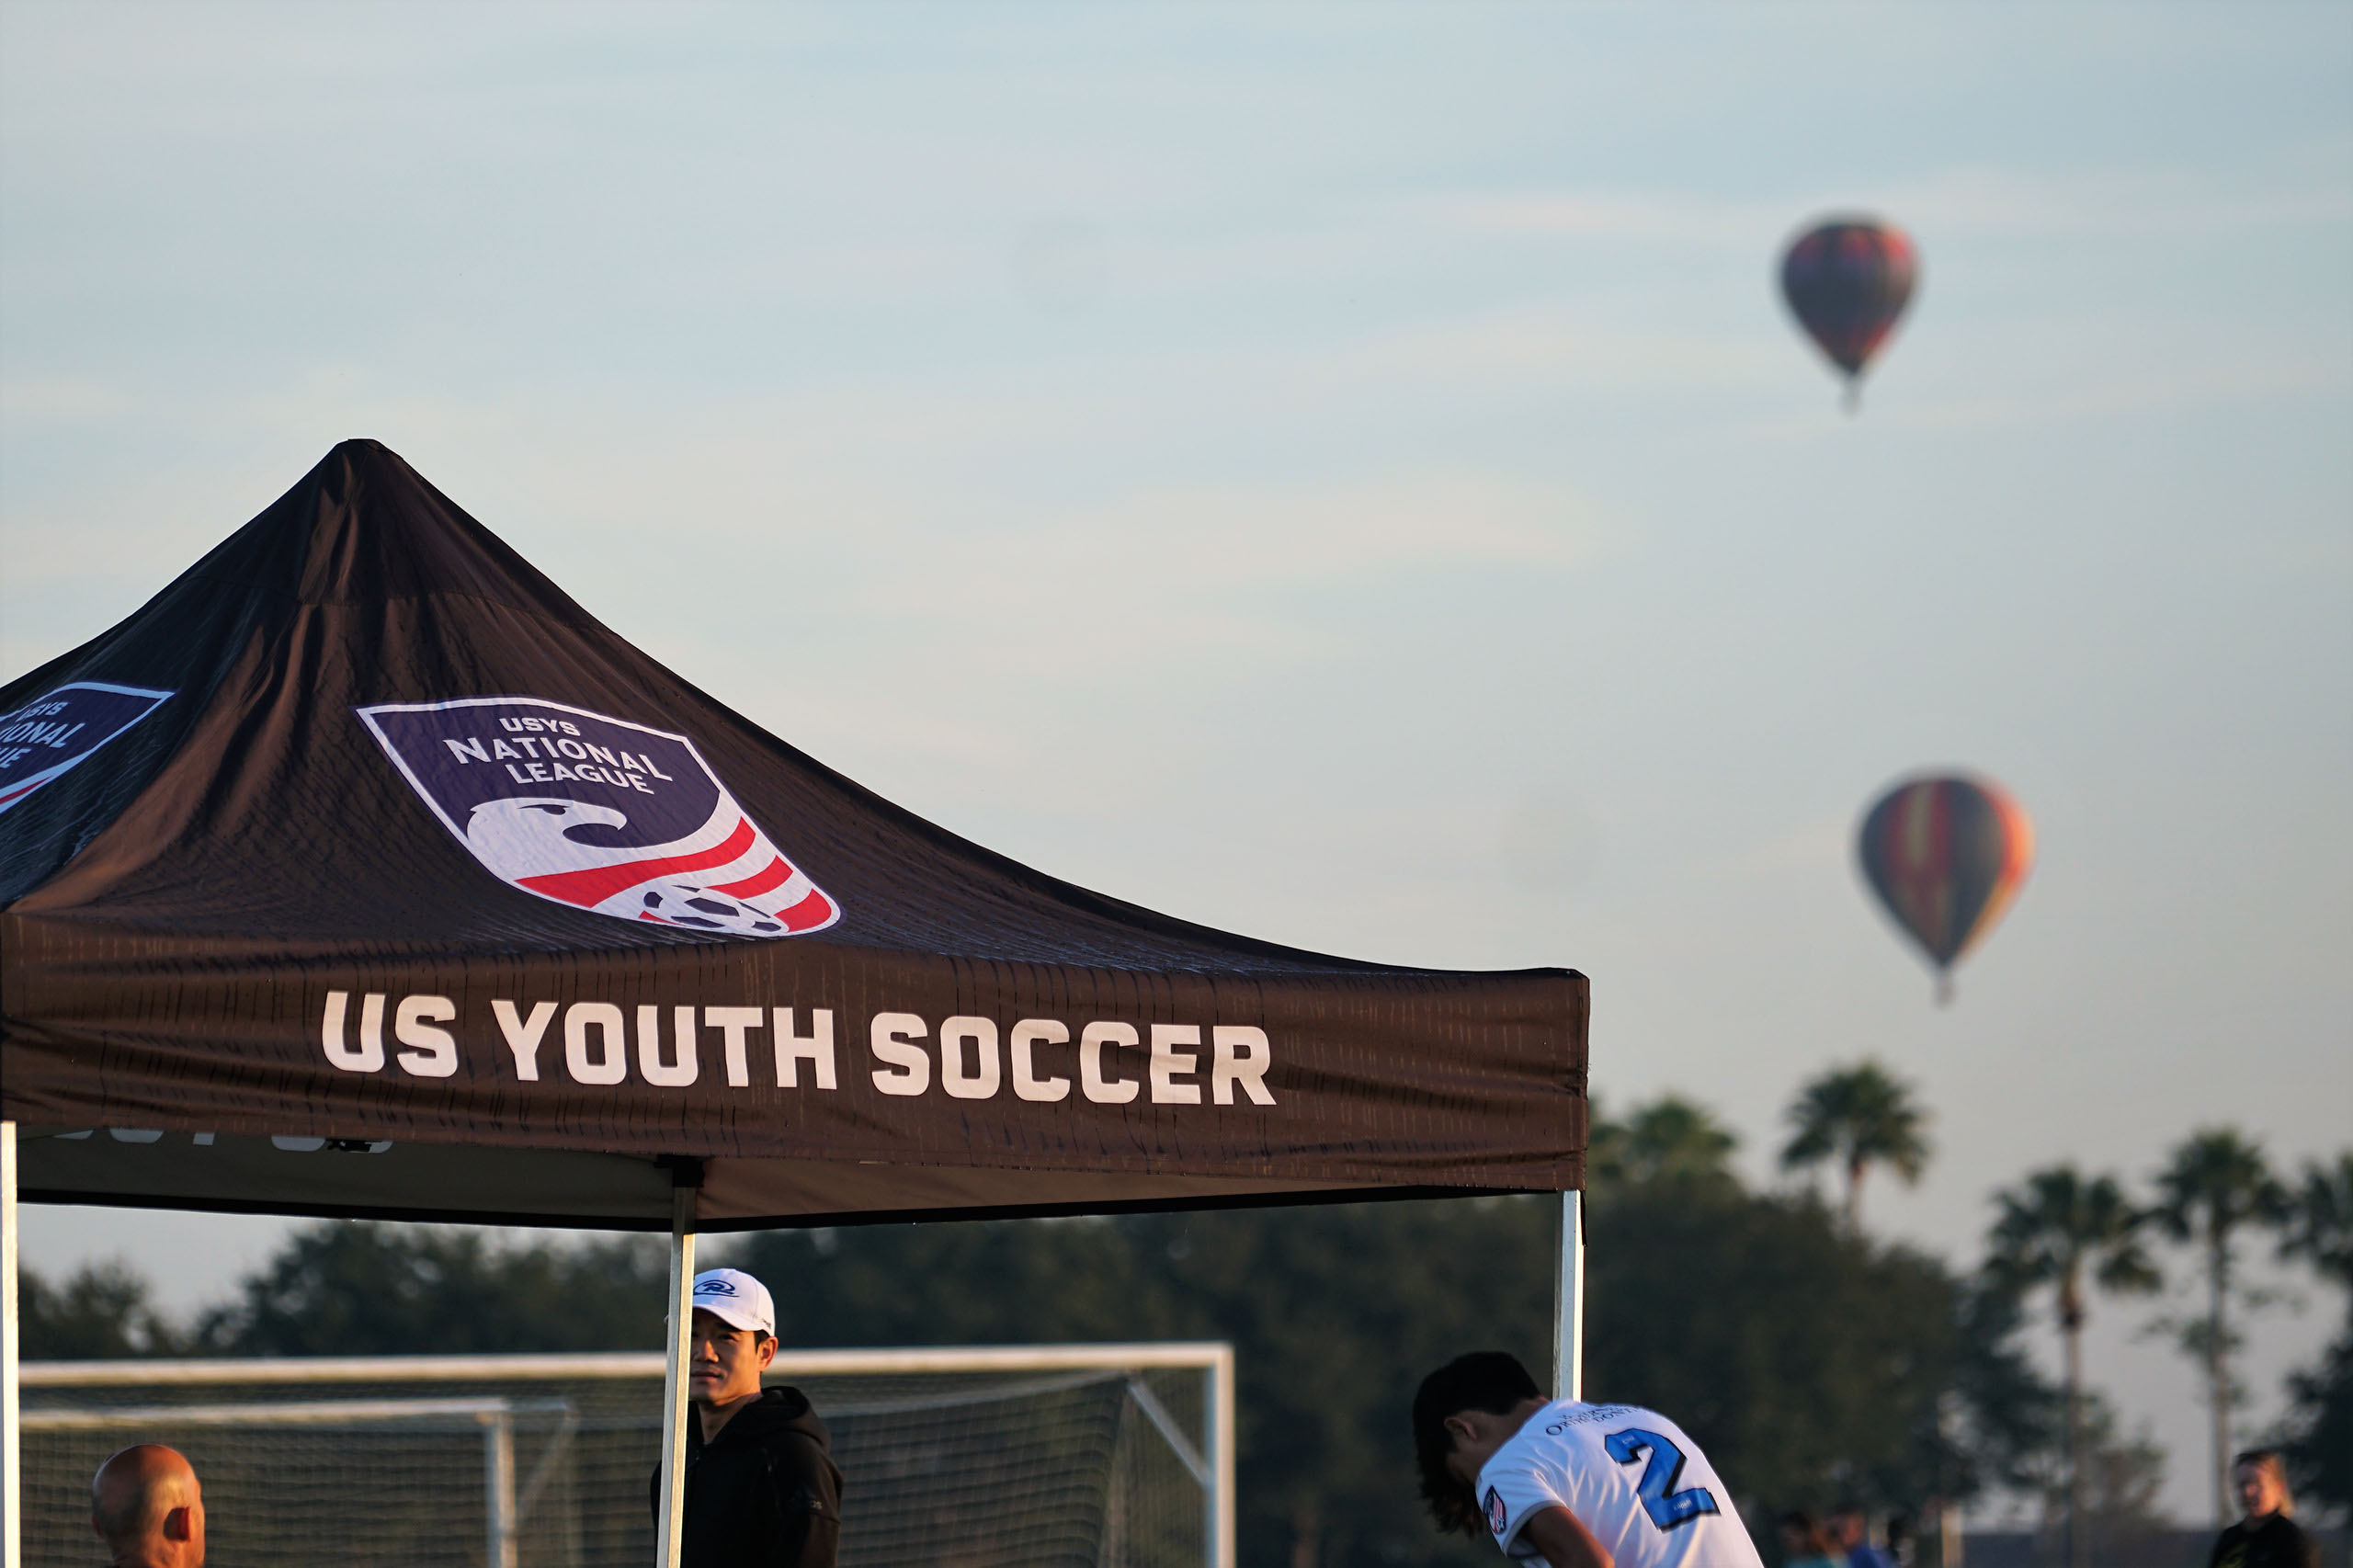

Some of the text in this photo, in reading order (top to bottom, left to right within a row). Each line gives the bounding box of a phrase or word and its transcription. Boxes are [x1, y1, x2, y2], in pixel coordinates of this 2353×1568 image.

[499, 717, 581, 737] USYS
[442, 737, 673, 782] NATIONAL
[505, 763, 655, 794] LEAGUE
[322, 990, 1277, 1108] US YOUTH SOCCER
[1604, 1427, 1722, 1534] 2
